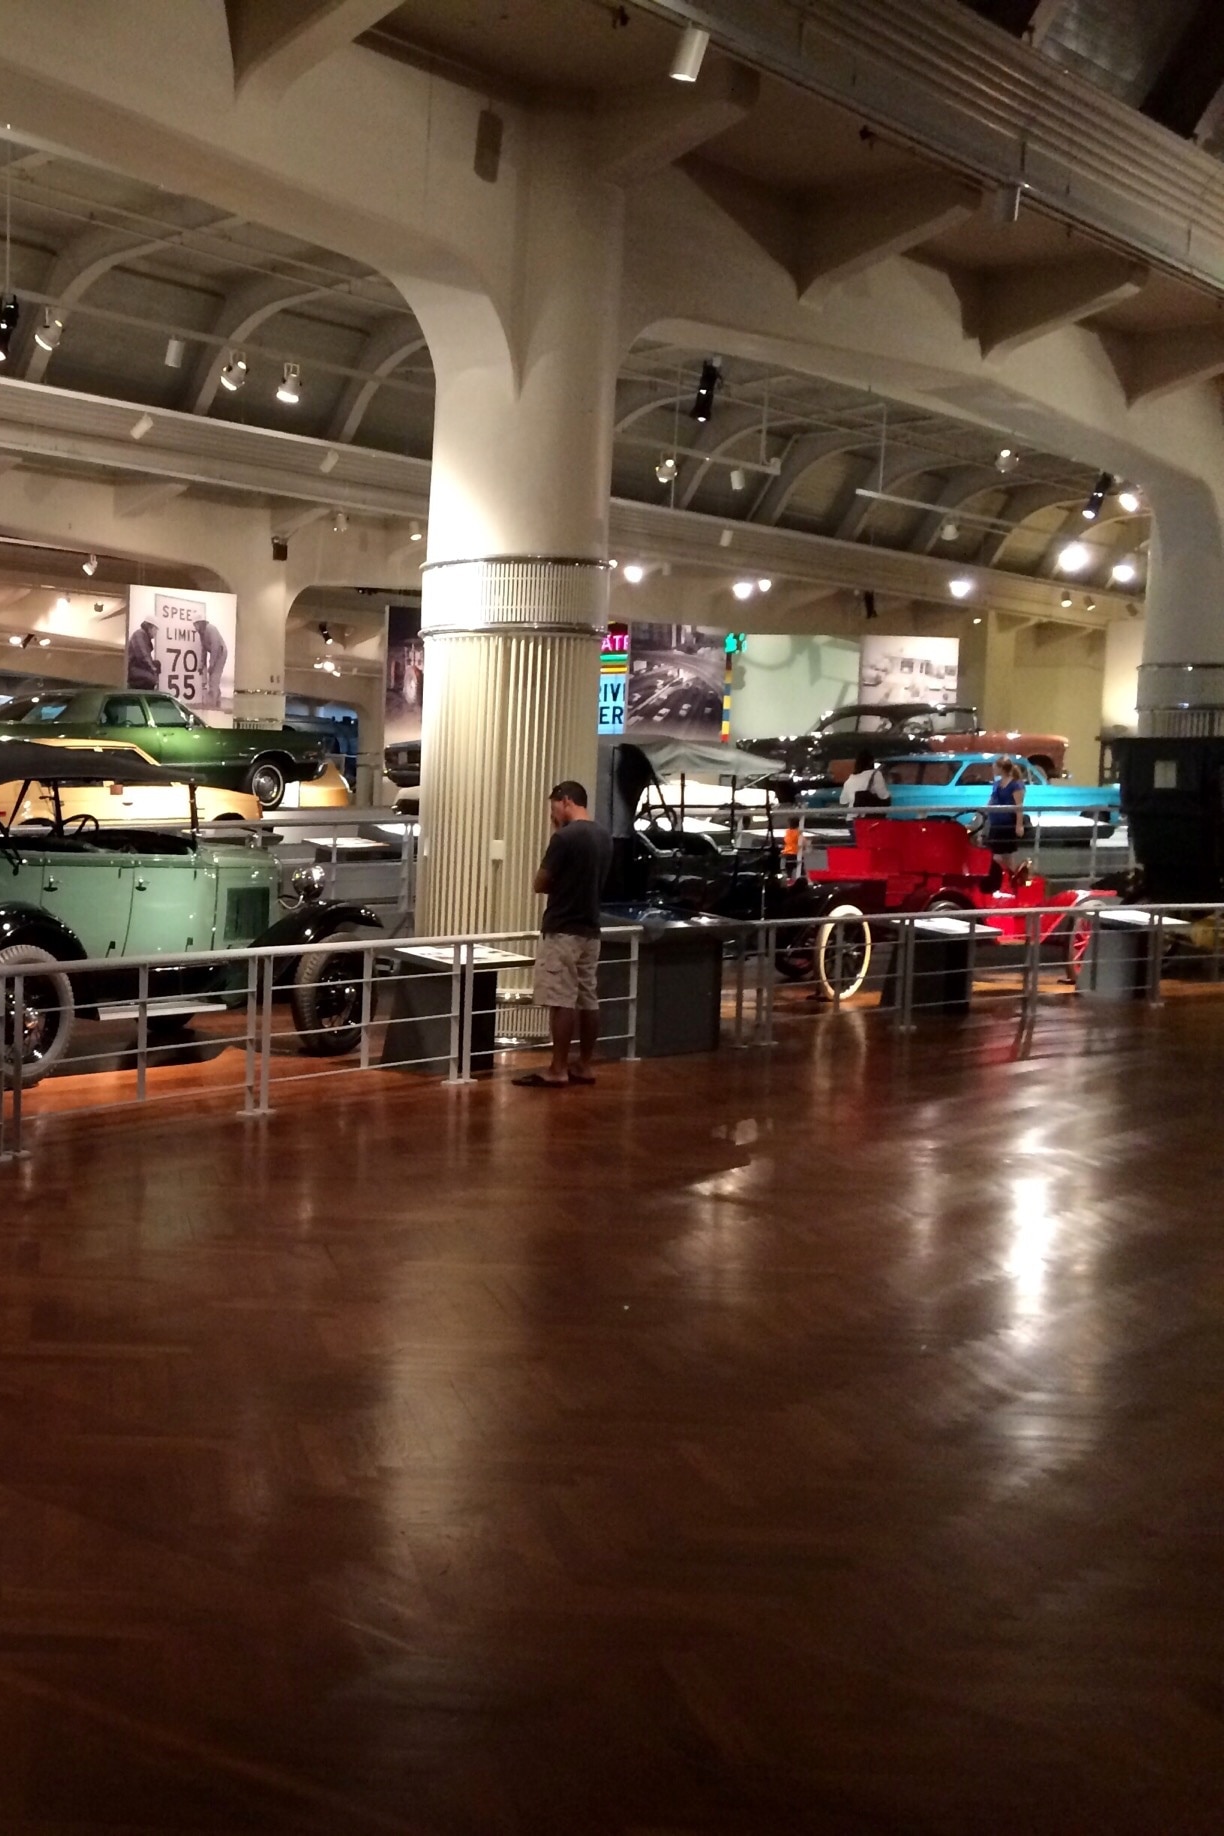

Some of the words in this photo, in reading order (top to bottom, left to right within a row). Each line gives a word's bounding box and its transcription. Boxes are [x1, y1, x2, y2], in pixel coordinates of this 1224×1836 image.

[162, 605, 197, 621] SPEE
[166, 627, 197, 642] LIMIT
[166, 648, 198, 673] 70
[167, 674, 196, 700] 55
[599, 706, 624, 725] ER
